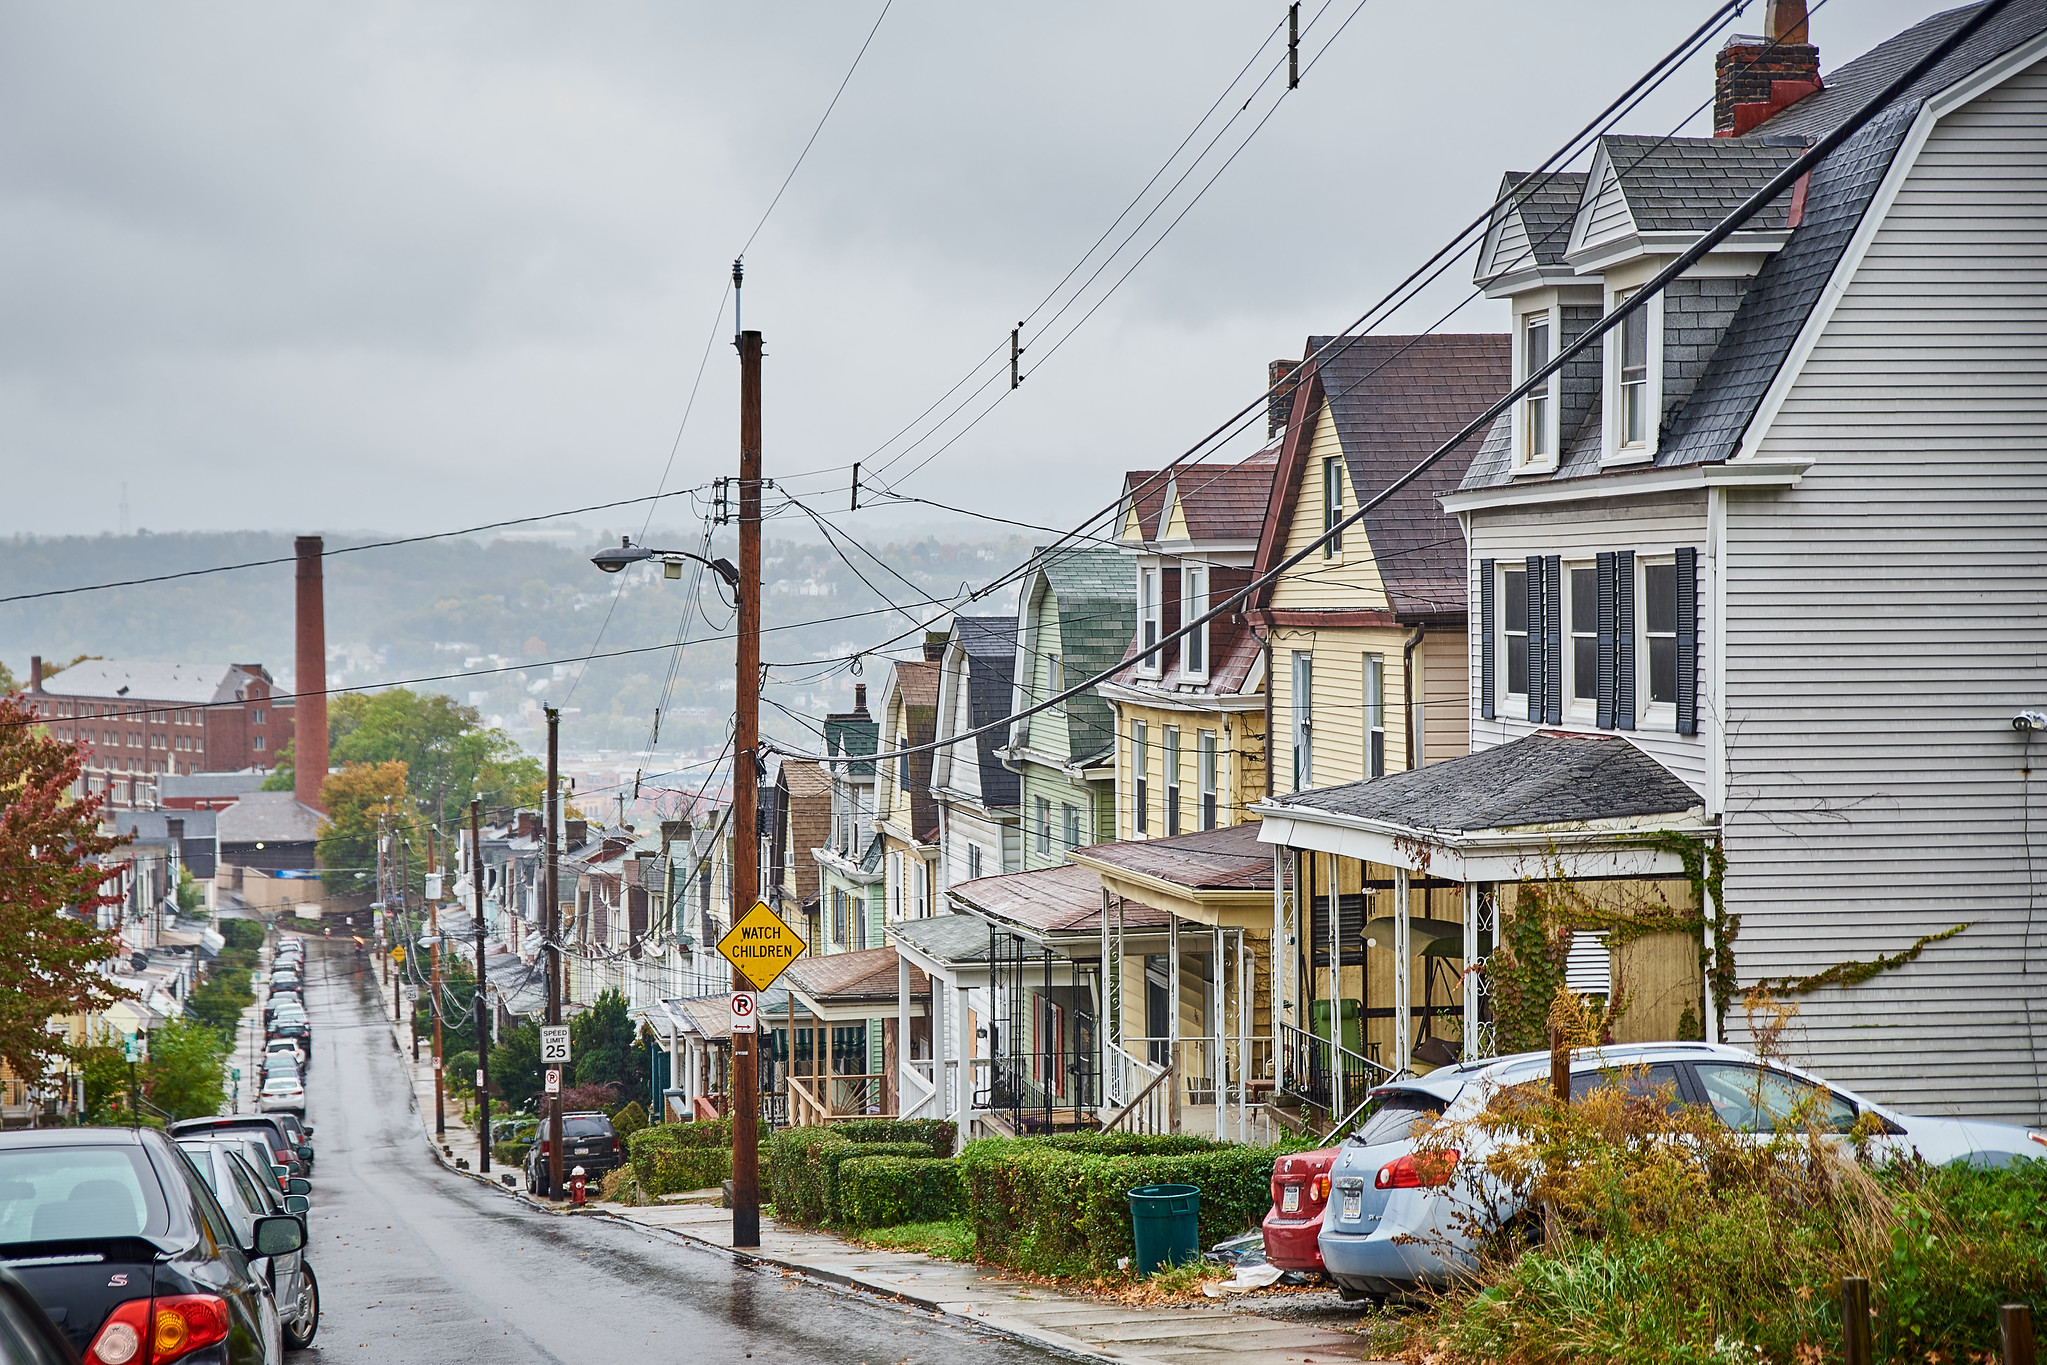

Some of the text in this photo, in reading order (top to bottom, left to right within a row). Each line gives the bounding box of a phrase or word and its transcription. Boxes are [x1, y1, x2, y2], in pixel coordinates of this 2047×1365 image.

[741, 926, 781, 940] WATCH
[732, 945, 792, 958] CHILDREN
[543, 1029, 568, 1037] SPEED
[546, 1045, 566, 1058] 25
[107, 1273, 129, 1287] S
